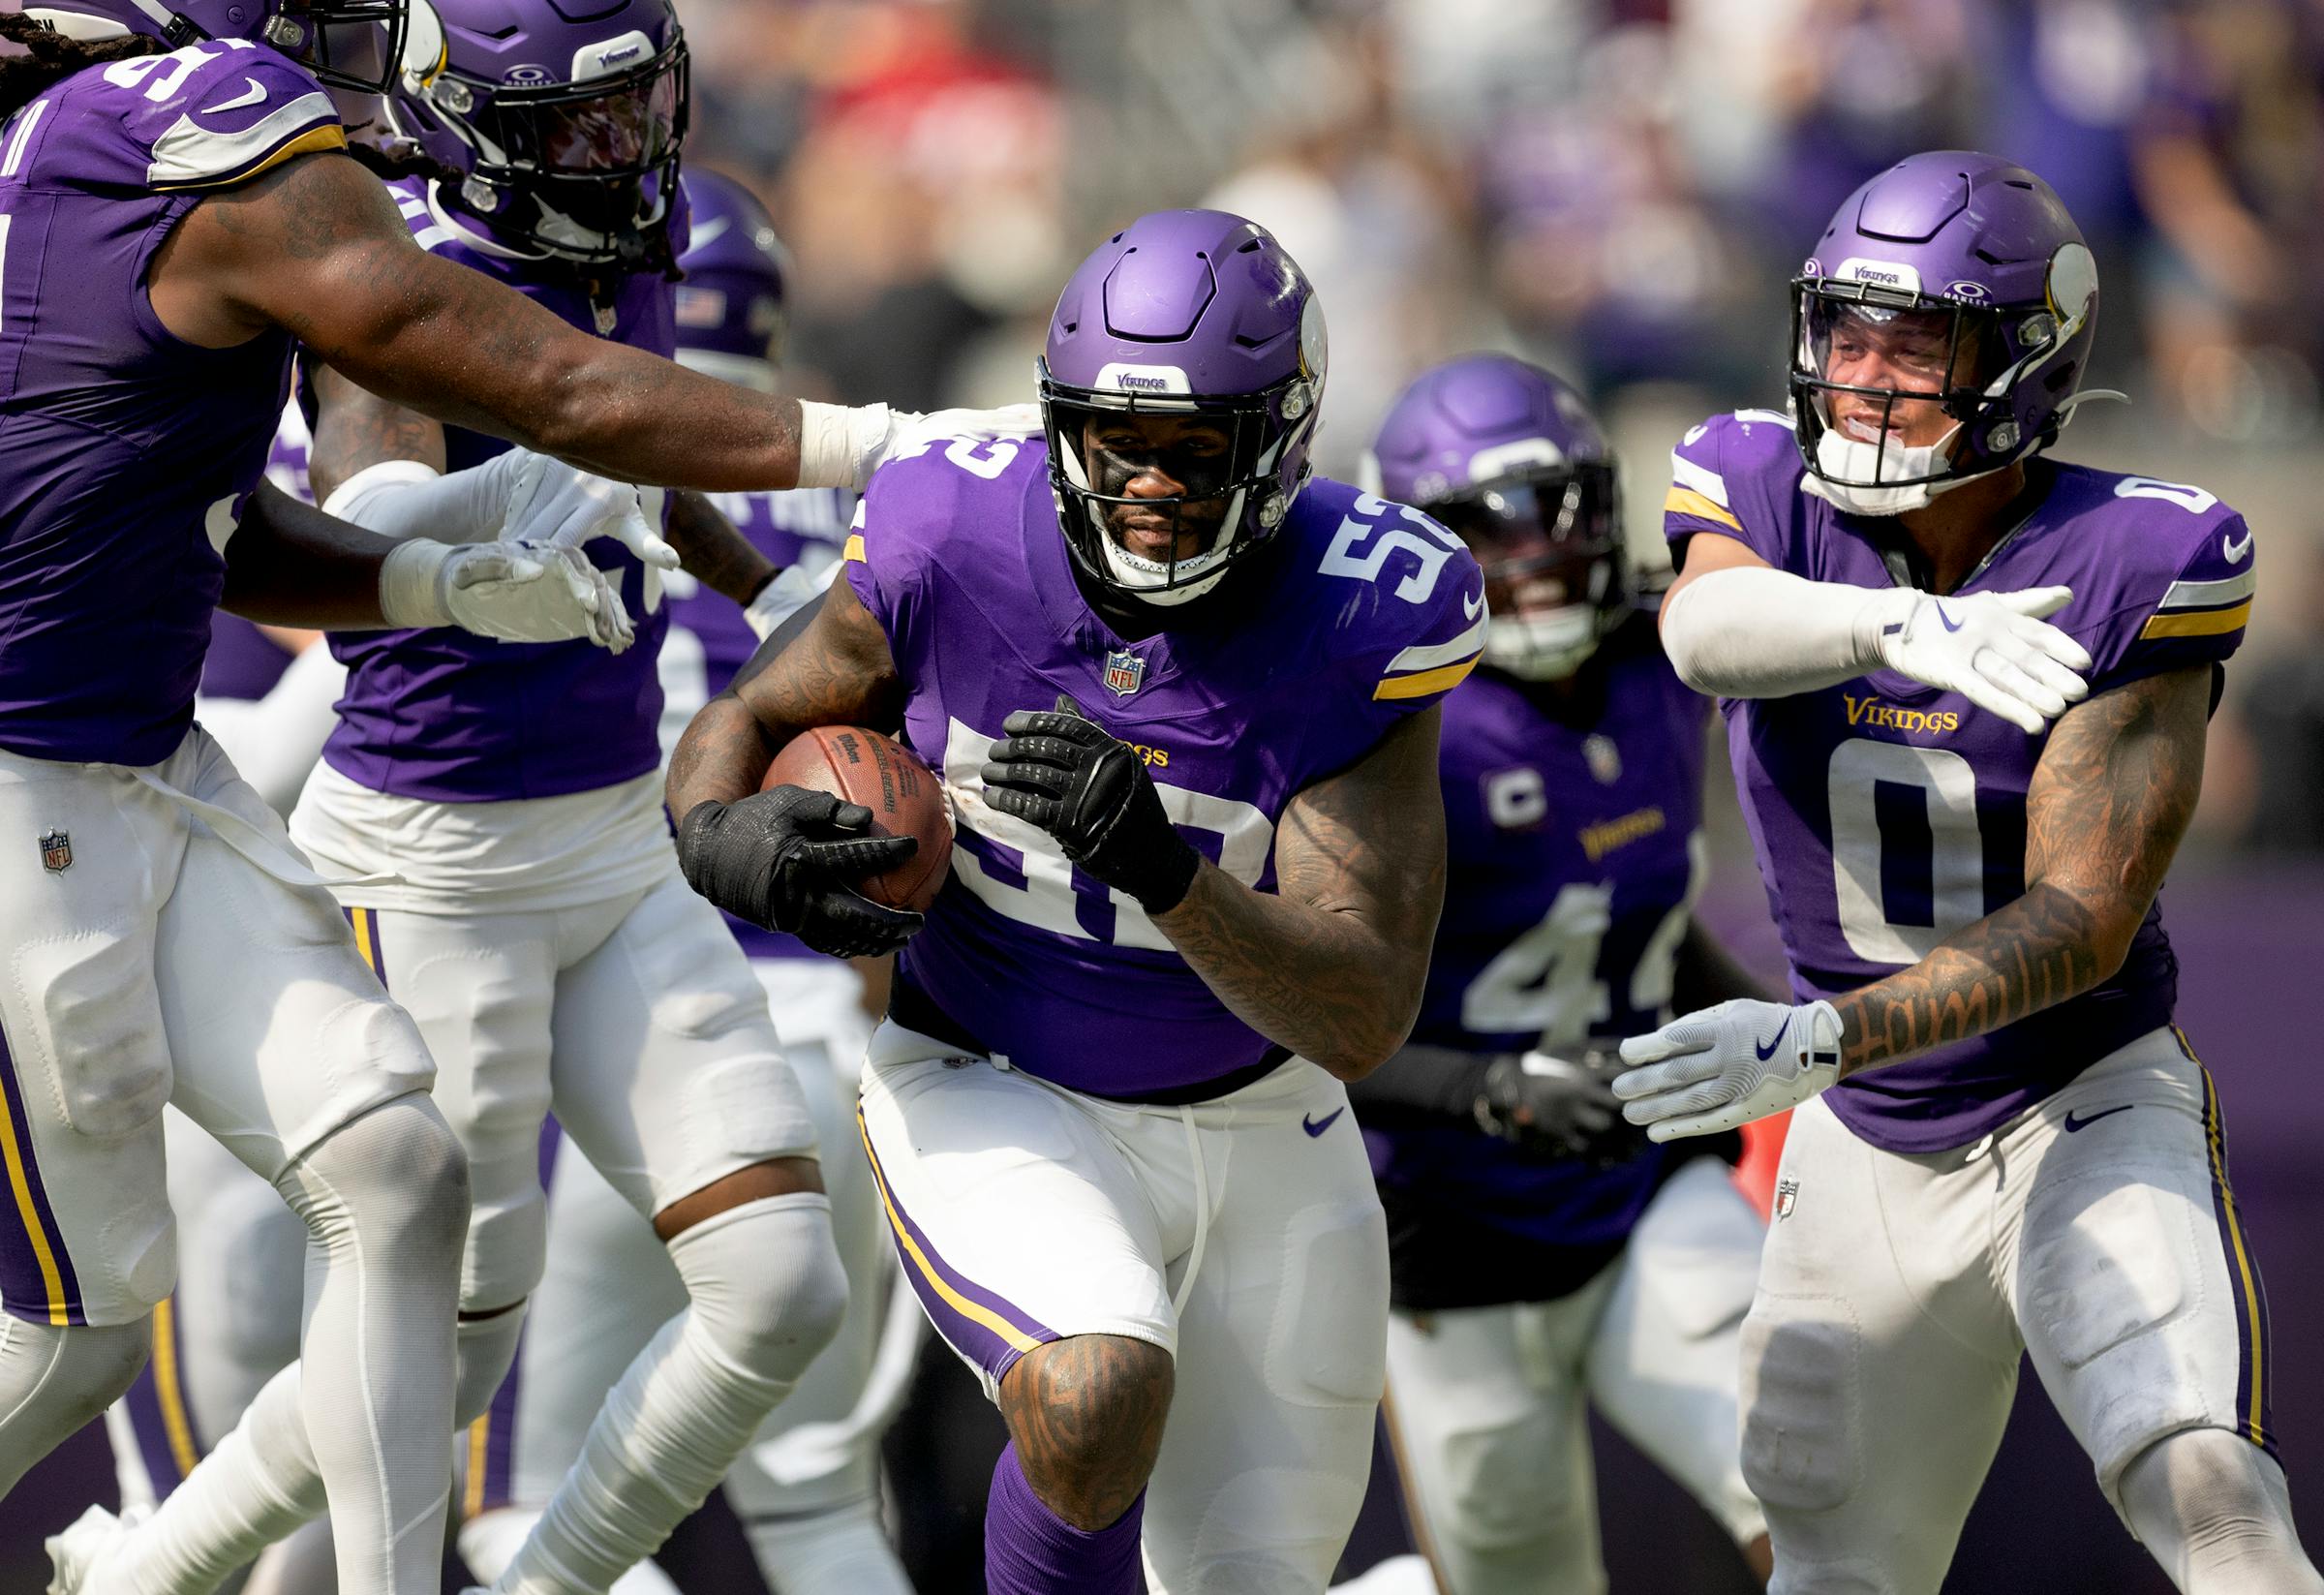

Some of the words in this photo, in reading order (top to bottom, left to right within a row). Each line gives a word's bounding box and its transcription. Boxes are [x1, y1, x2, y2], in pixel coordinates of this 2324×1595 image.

[1943, 291, 1990, 307] OAKLEY
[1110, 668, 1134, 689] NFL
[46, 847, 70, 868] NFL
[1827, 737, 1984, 966] 0
